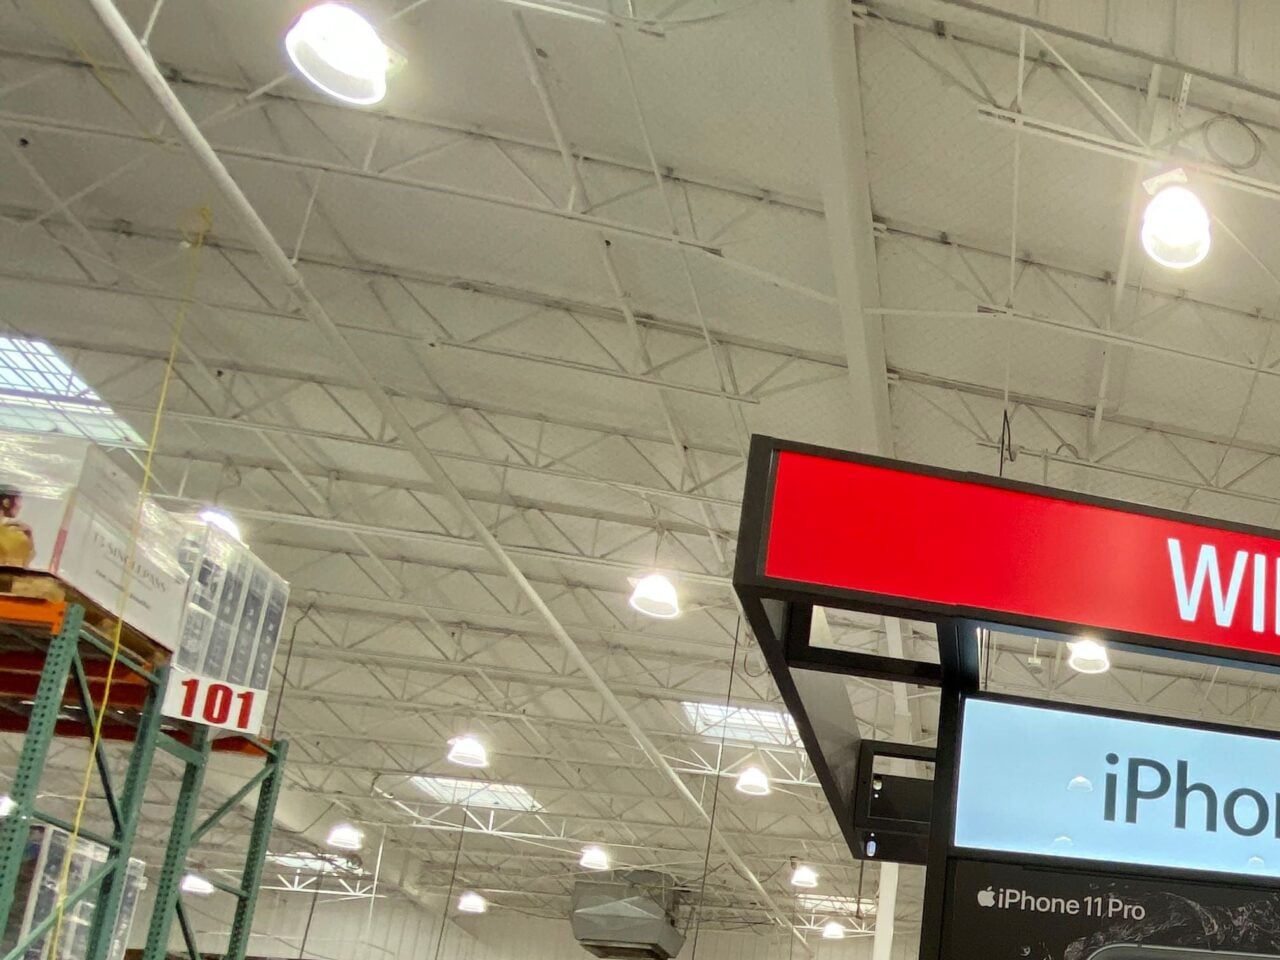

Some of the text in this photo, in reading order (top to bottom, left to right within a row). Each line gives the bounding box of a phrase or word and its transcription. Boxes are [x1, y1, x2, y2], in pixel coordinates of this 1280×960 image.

[180, 678, 254, 729] 101
[998, 888, 1145, 921] iPhone 11 Pro
